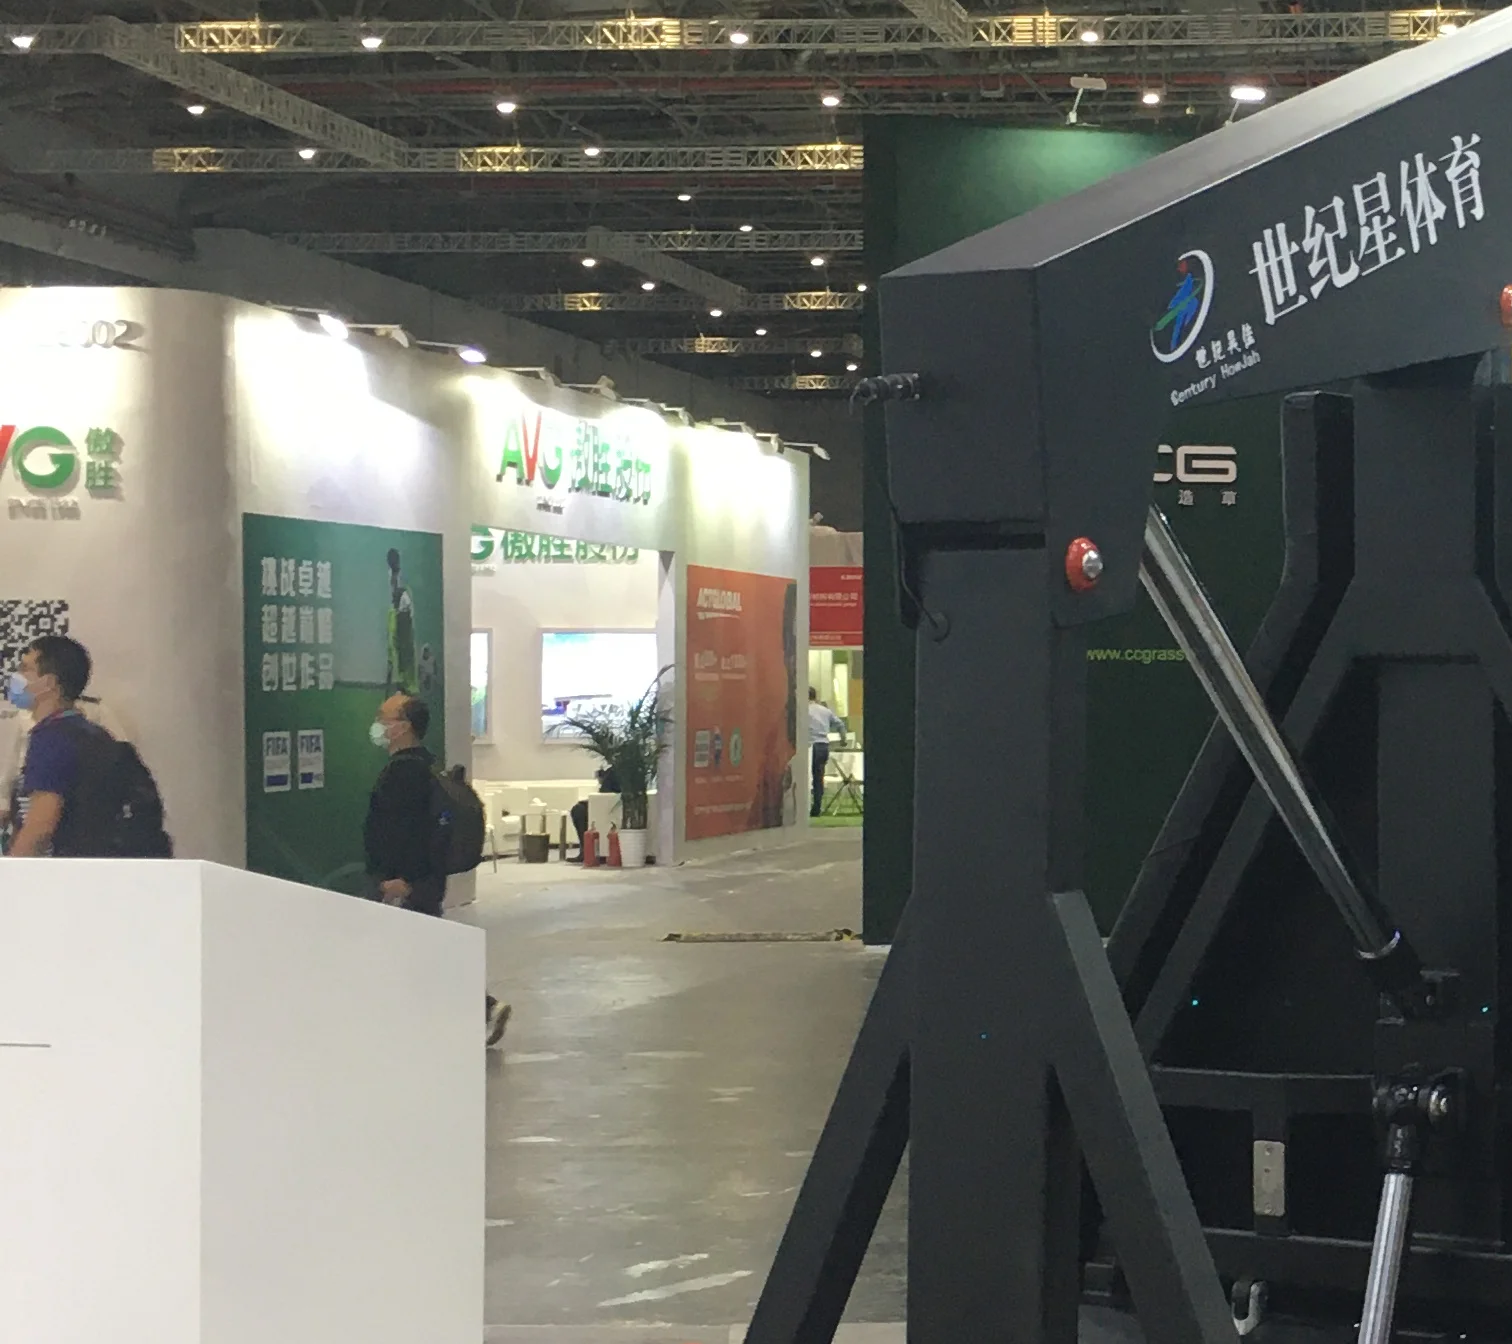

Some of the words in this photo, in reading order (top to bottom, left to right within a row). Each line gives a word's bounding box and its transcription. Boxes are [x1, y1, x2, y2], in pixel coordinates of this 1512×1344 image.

[1248, 133, 1486, 326] 世纪星体育
[1170, 373, 1217, 407] Century
[265, 737, 288, 756] FIFA
[300, 735, 321, 753] FIFA
